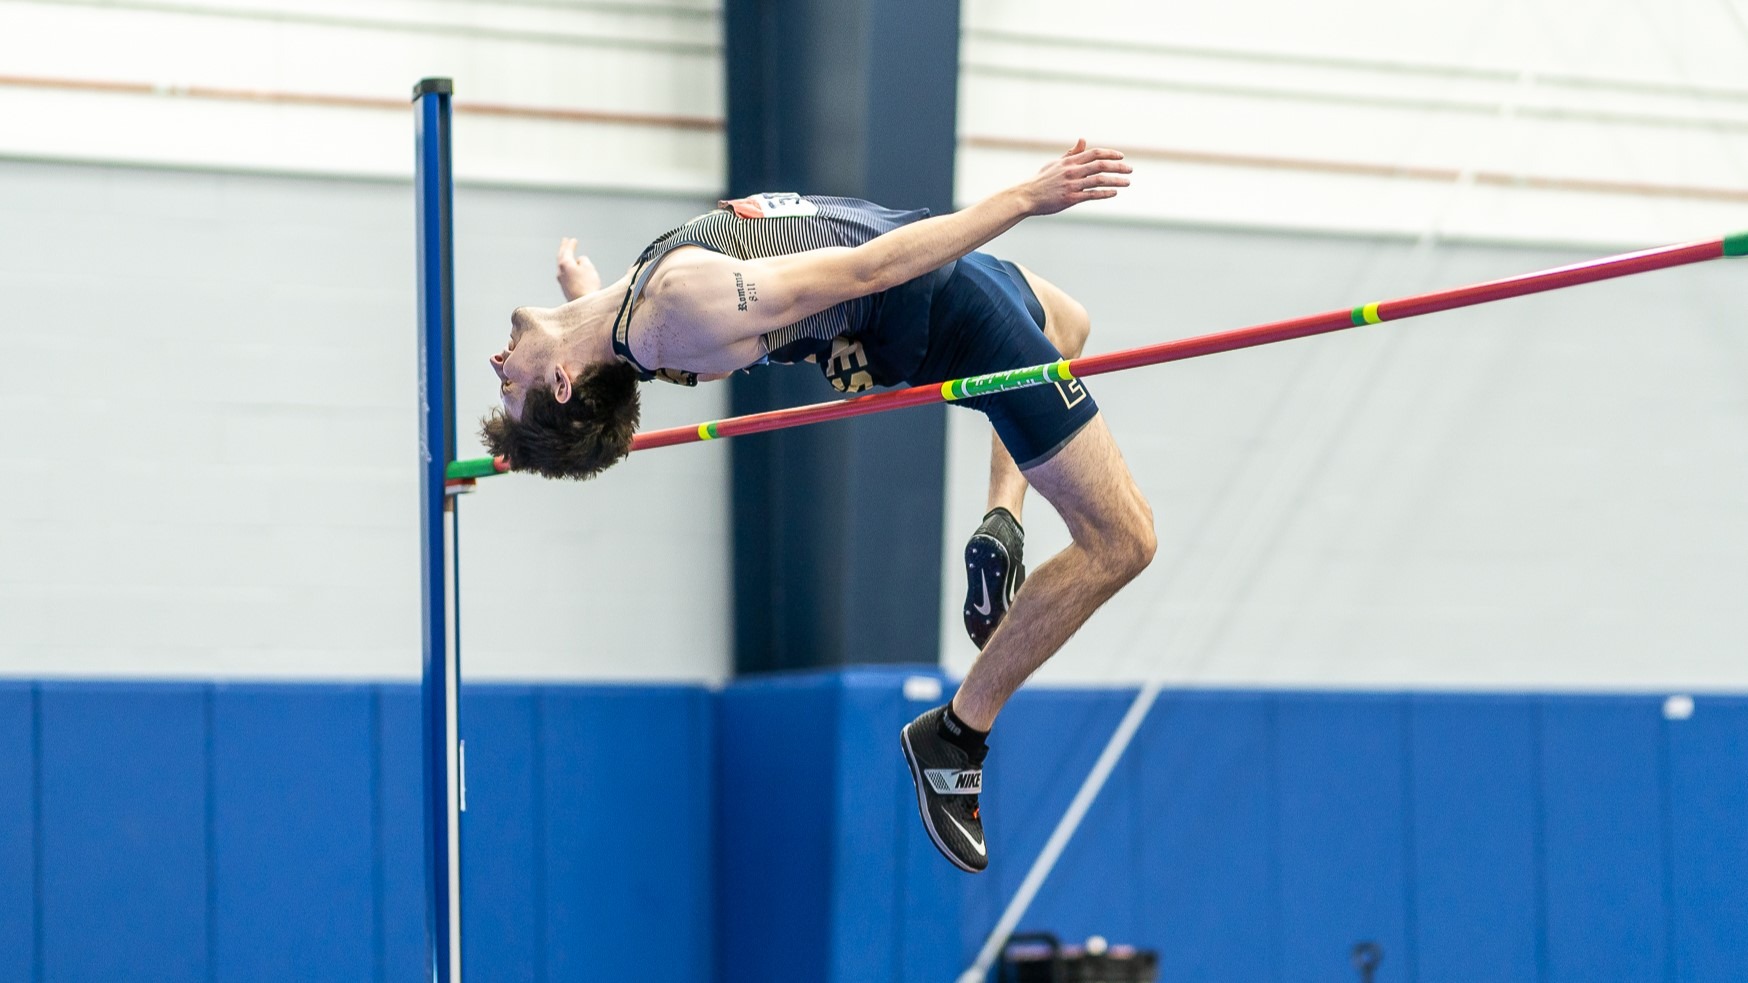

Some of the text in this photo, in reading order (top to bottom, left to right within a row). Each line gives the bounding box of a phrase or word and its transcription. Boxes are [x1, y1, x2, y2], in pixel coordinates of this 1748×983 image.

[733, 272, 748, 312] Romans
[826, 336, 874, 393] ES
[955, 773, 981, 789] NIKE
